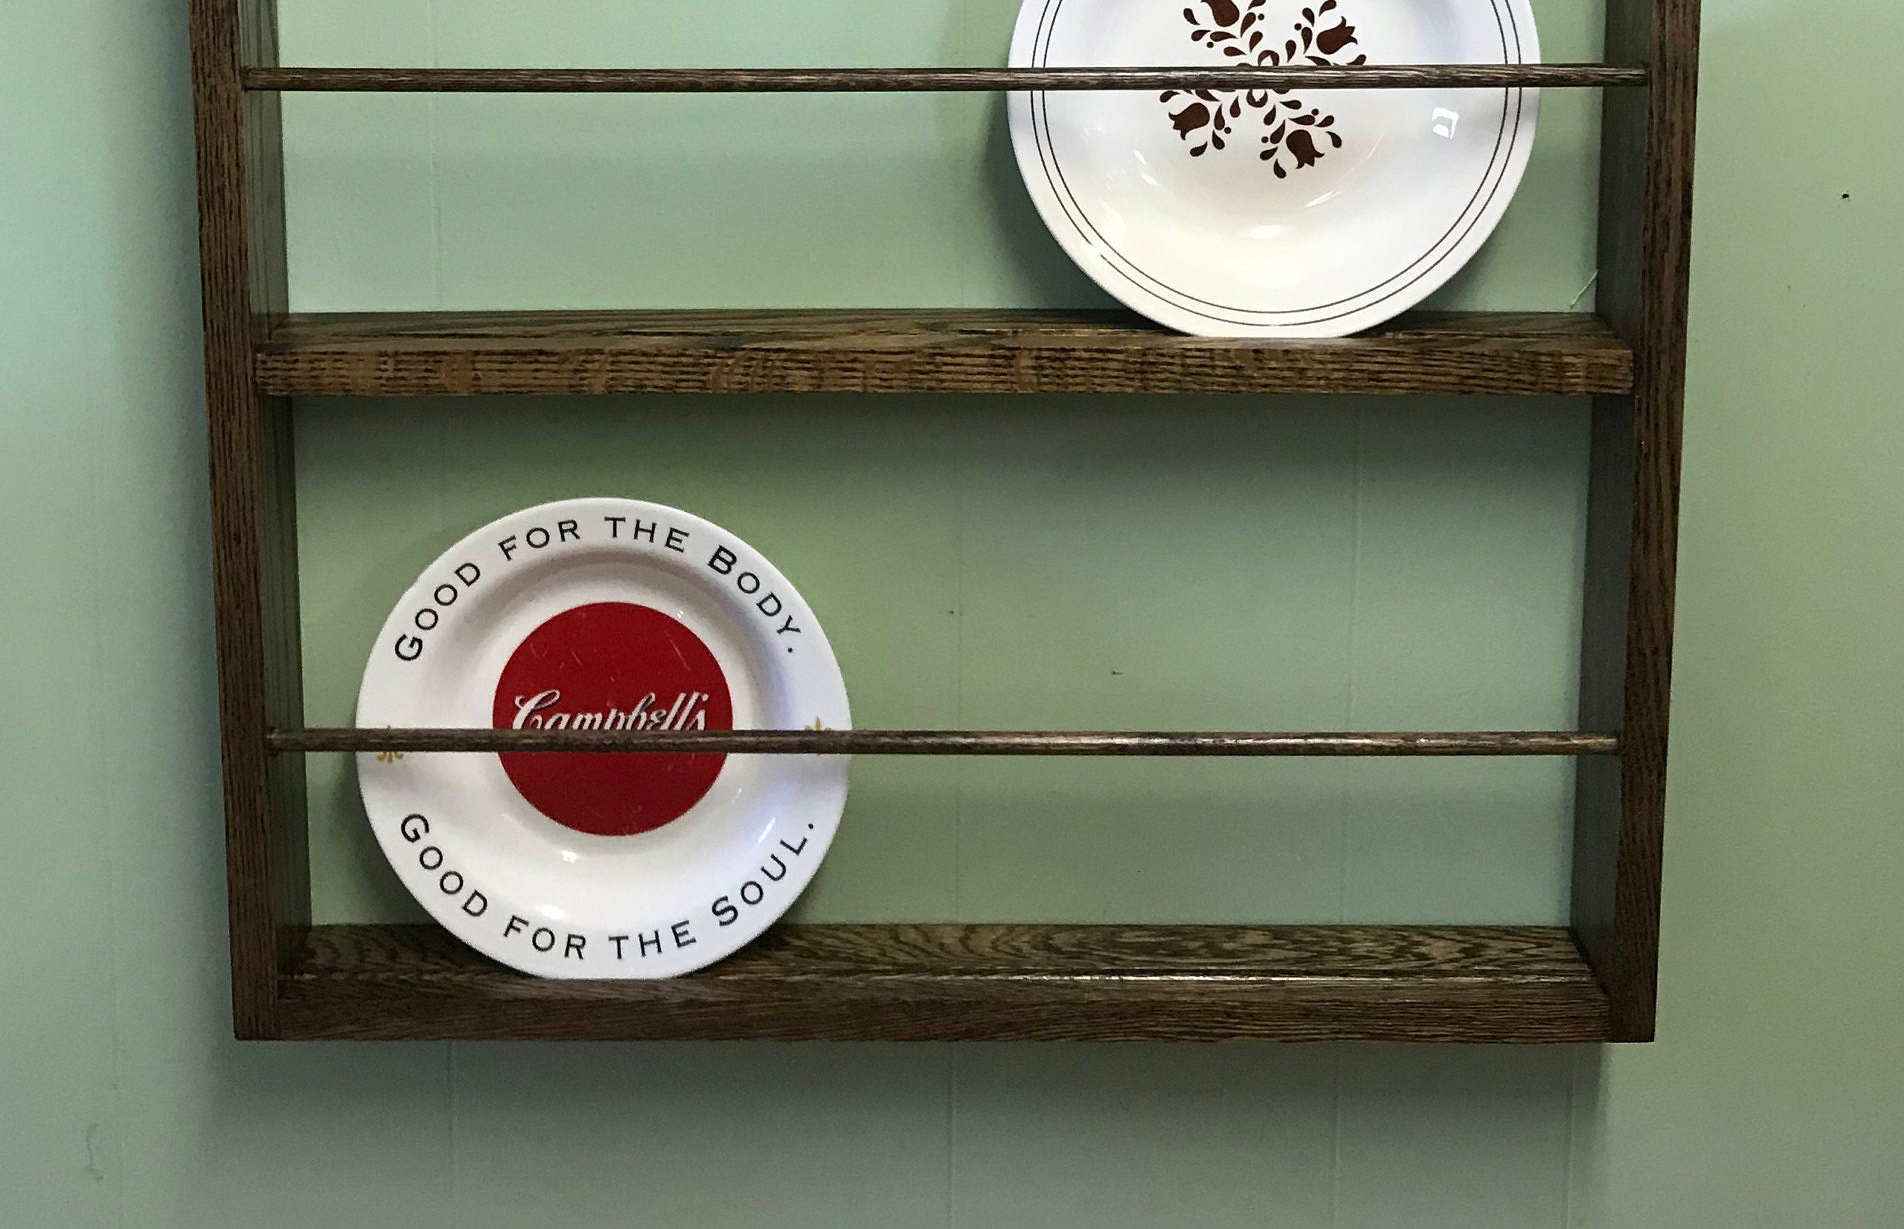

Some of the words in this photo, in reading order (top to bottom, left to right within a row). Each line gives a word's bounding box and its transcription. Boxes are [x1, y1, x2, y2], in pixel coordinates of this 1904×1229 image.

[394, 562, 481, 662] GOOD
[498, 519, 581, 561] FOR
[604, 516, 690, 553] THE
[707, 544, 801, 654] BODY.
[400, 813, 488, 917] GOOD
[503, 914, 587, 960] FOR
[608, 920, 697, 960] THE
[711, 823, 814, 927] SOUL.
